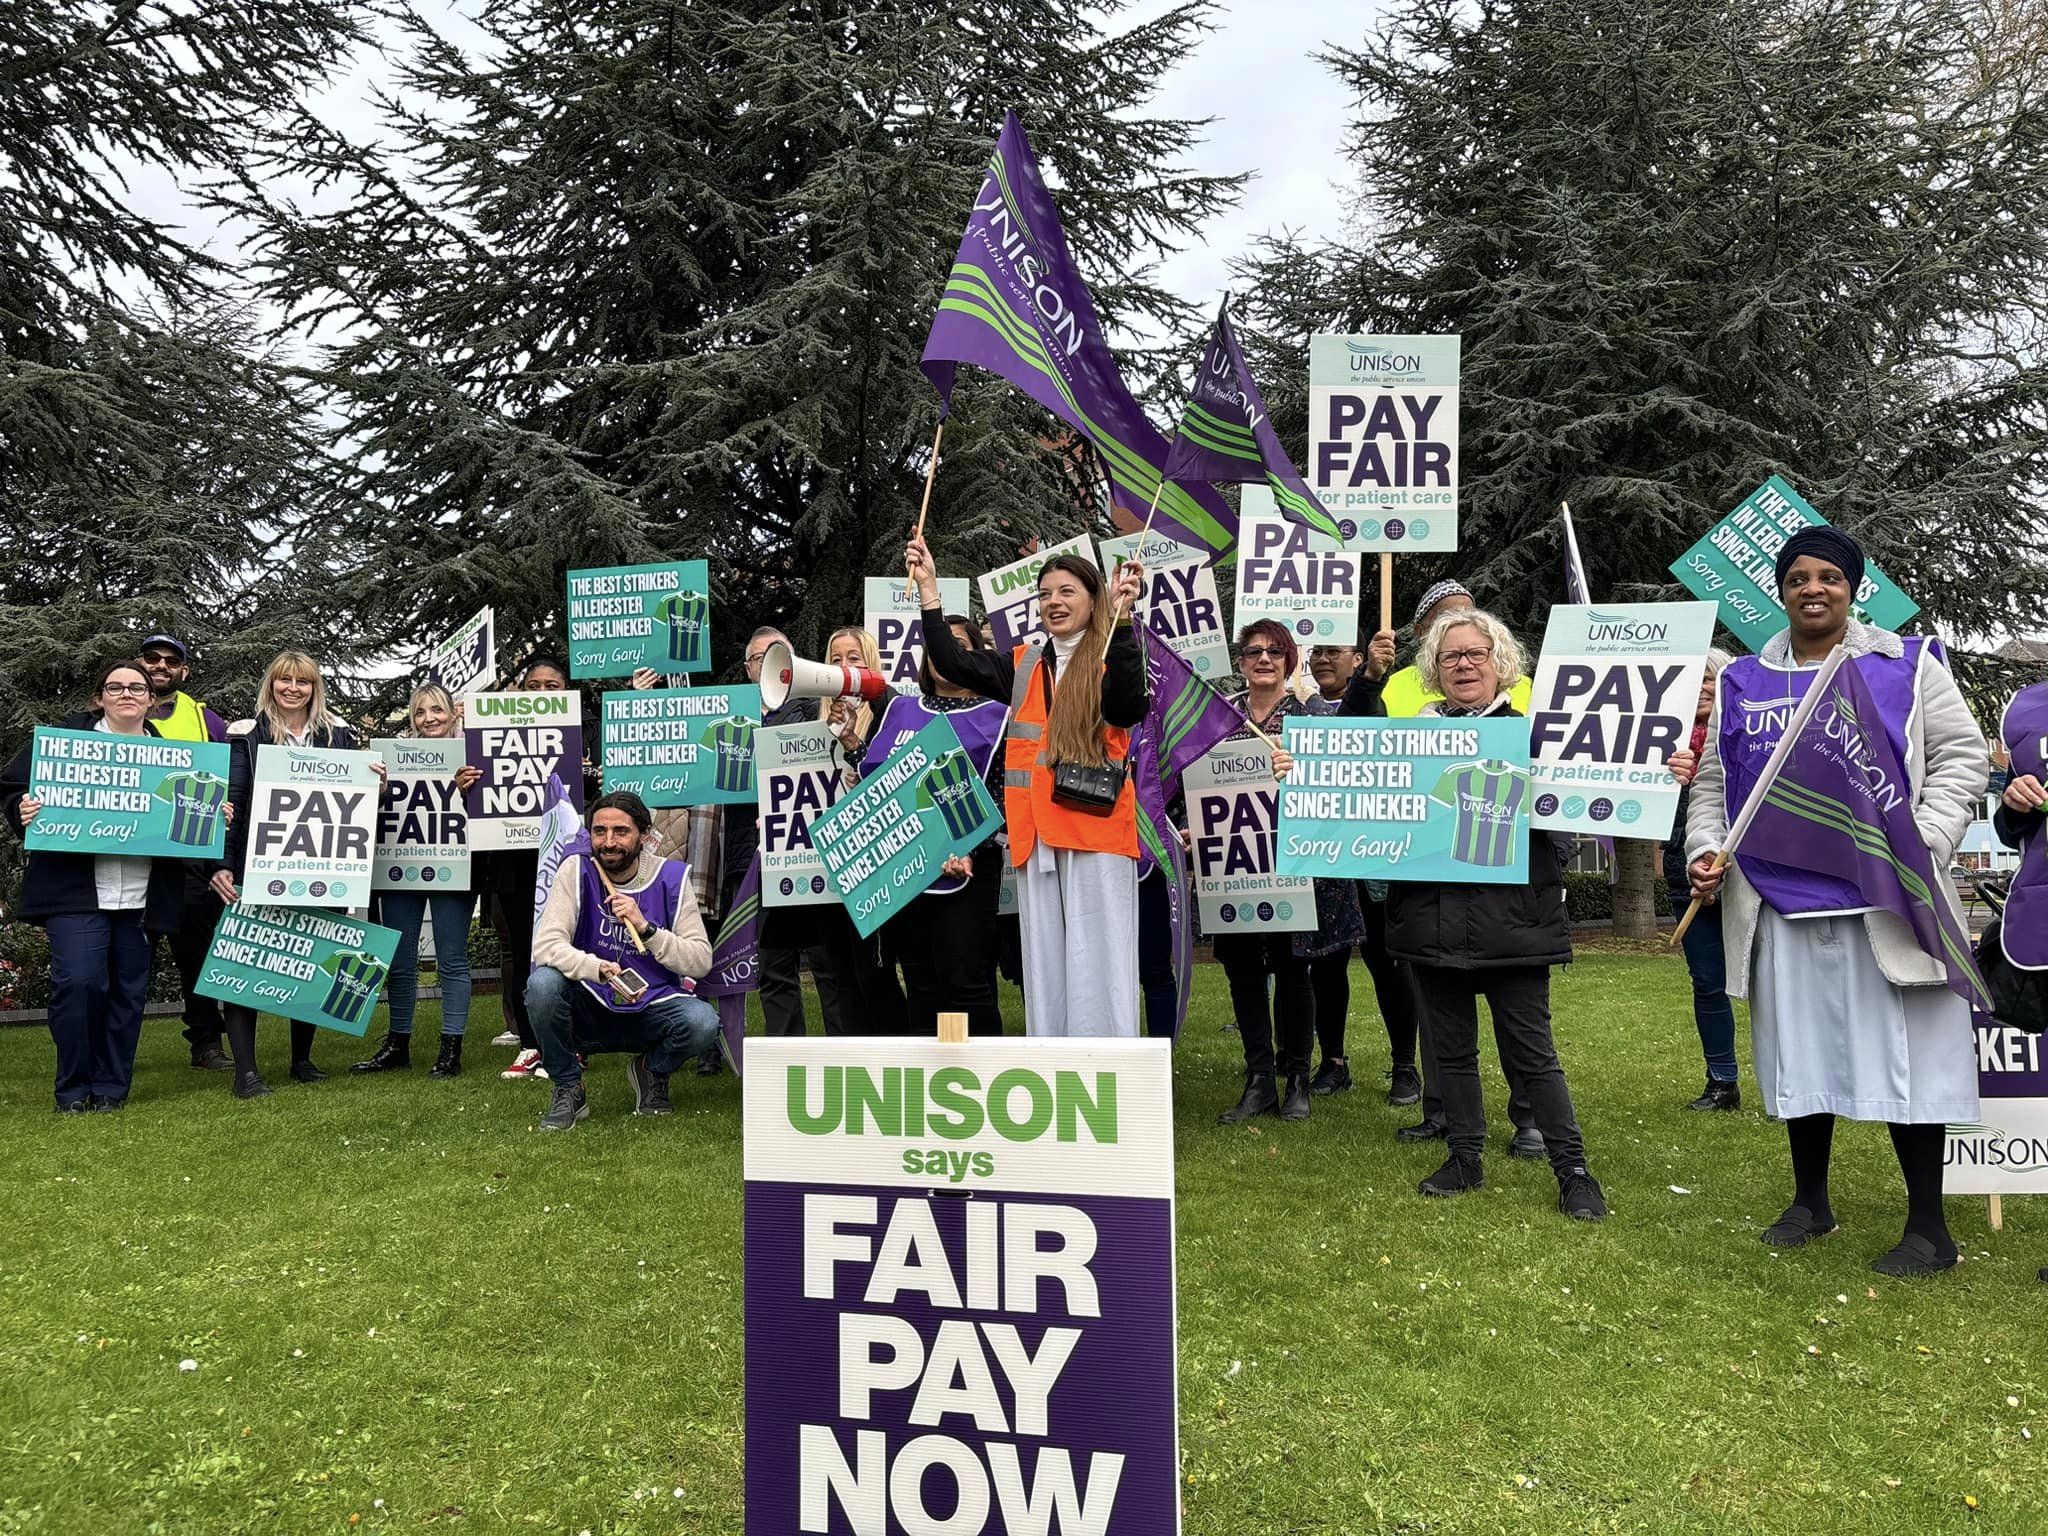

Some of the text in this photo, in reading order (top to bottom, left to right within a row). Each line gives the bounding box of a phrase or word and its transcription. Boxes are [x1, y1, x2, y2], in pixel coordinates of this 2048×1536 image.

[973, 178, 1084, 357] UNISON
[974, 227, 1073, 382] public service union
[1350, 355, 1421, 371] UNISON
[1214, 388, 1241, 406] public
[1329, 395, 1443, 441] PAY
[1317, 442, 1452, 487] FAIR
[1316, 490, 1452, 507] for patient care
[1754, 485, 1814, 536] THE BE
[1731, 504, 1758, 530] IN
[1128, 539, 1178, 560] UNISON
[1254, 523, 1336, 558] PA
[1709, 525, 1757, 568] SINCE
[570, 570, 679, 597] THE BEST STRIKERS
[1243, 559, 1354, 595] FAIR
[1687, 553, 1726, 592] Sorry
[1725, 588, 1772, 625] Gary!
[570, 596, 643, 619] IN LEICESTER
[1005, 596, 1043, 638] FA
[1136, 598, 1218, 640] AIR
[1240, 597, 1354, 610] for patient care
[437, 613, 482, 657] UNISON
[571, 617, 652, 641] SINCE LINEKER
[879, 619, 924, 650] PA
[1193, 633, 1221, 645] care
[1588, 623, 1668, 640] UNISON
[437, 632, 480, 676] FAIR
[442, 647, 476, 687] PAY
[574, 643, 644, 668] Sorry Gary!
[879, 651, 919, 682] FA
[444, 657, 481, 695] OW
[1549, 664, 1687, 713] PAY
[475, 696, 568, 717] UNISON
[509, 716, 535, 726] says
[605, 694, 729, 719] THE BEST STRIKERS
[482, 728, 564, 757] FAIR
[605, 720, 688, 743] IN LEICESTER
[780, 737, 826, 755] UNISON
[1288, 728, 1478, 757] THE BEST STRIKERS
[1530, 712, 1684, 765] FAIR
[39, 735, 193, 768] THE BEST STRIKERS
[397, 752, 444, 764] UNISON
[605, 744, 698, 767] SINCE LINEKER
[1211, 755, 1266, 775] UNISON
[1813, 743, 1831, 756] the
[1825, 711, 1903, 812] UNISON
[35, 760, 141, 788] IN LEICESTER
[290, 761, 350, 776] UNISON
[493, 757, 559, 785] PAY
[1286, 760, 1306, 785] IN
[1310, 760, 1412, 788] LEICESTER
[1530, 764, 1676, 785] or patient care
[34, 785, 151, 813] SINCE LINEKER
[384, 780, 457, 811] PAY
[607, 772, 689, 797] Sorry Gary!
[770, 768, 842, 813] PAY
[815, 822, 843, 850] THE
[837, 792, 871, 828] BEST
[867, 745, 927, 806] STRIKERS
[177, 799, 215, 813] UNISON
[268, 788, 366, 825] PAY
[1284, 792, 1427, 821] SINCE LINEKER
[1462, 801, 1512, 817] UNISON
[33, 818, 138, 842] Sorry Gary!
[254, 822, 370, 860] FAIR
[377, 813, 466, 844] FAIR
[505, 826, 541, 838] UNISO
[765, 811, 823, 852] FA
[825, 798, 904, 873] IN LEICESTER
[376, 846, 467, 859] for patient care
[766, 854, 820, 868] for patien
[837, 812, 924, 894] SINCE LINEKER
[1286, 832, 1412, 864] Sorry Gary!
[251, 858, 368, 872] for patient care
[855, 846, 928, 920] Sorry Gary!
[1200, 877, 1308, 893] for patient care
[221, 916, 315, 957] IN LEICESTER
[230, 903, 366, 948] THE BEST STRIKERS
[213, 938, 317, 982] SINCE LINEKER
[205, 968, 298, 1004] Sorry Gary!
[1972, 1027, 2041, 1072] KET
[787, 1064, 1118, 1144] UNISON
[902, 1147, 995, 1183] says
[803, 1193, 1102, 1317] FAIR
[839, 1311, 1084, 1437] PAY
[799, 1423, 1126, 1536] NOW
